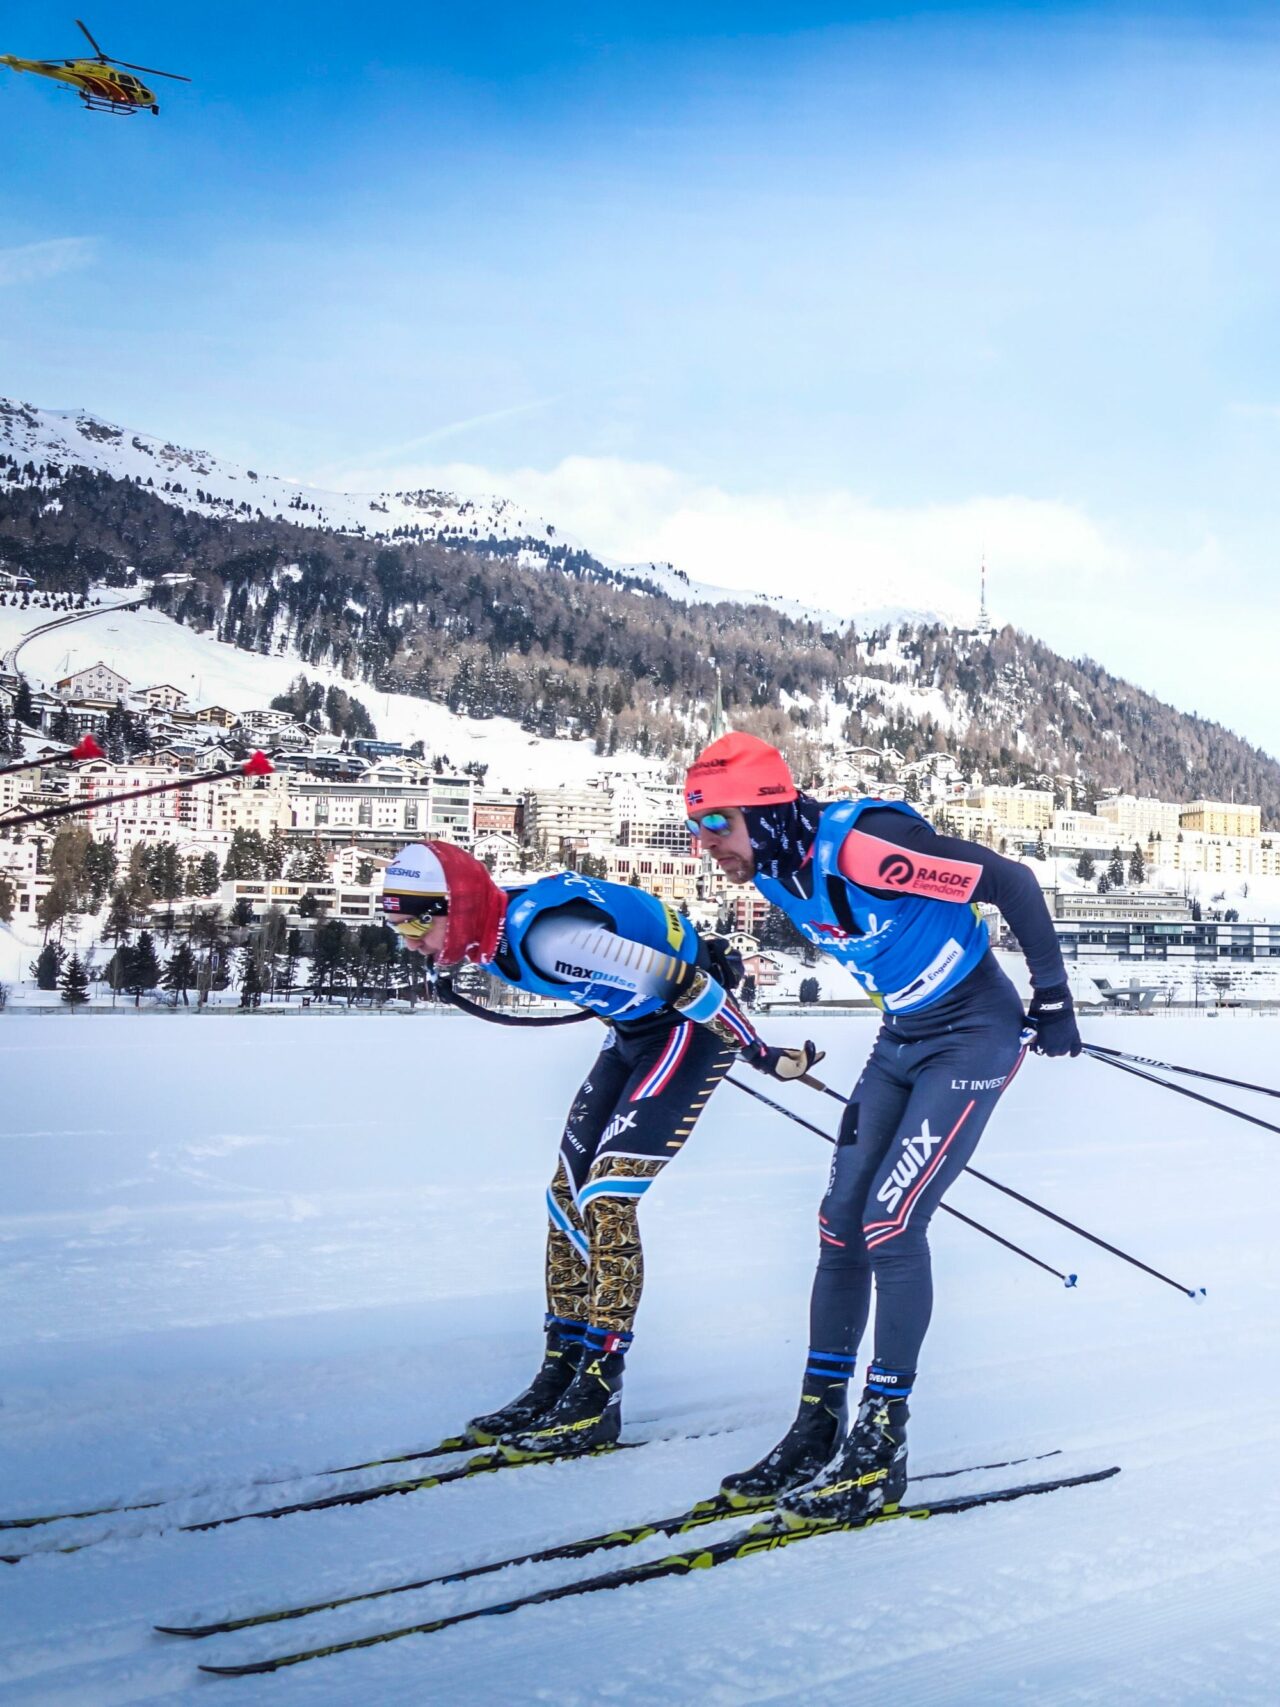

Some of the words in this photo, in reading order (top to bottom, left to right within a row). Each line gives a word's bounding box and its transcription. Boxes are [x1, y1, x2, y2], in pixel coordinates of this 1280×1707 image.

[912, 880, 965, 898] Eiendom
[916, 868, 972, 888] RAGDE
[554, 960, 637, 989] maxpulse
[927, 950, 959, 981] Engadin
[951, 1079, 968, 1090] LT
[971, 1076, 1007, 1090] INVEST
[595, 1109, 638, 1155] wix
